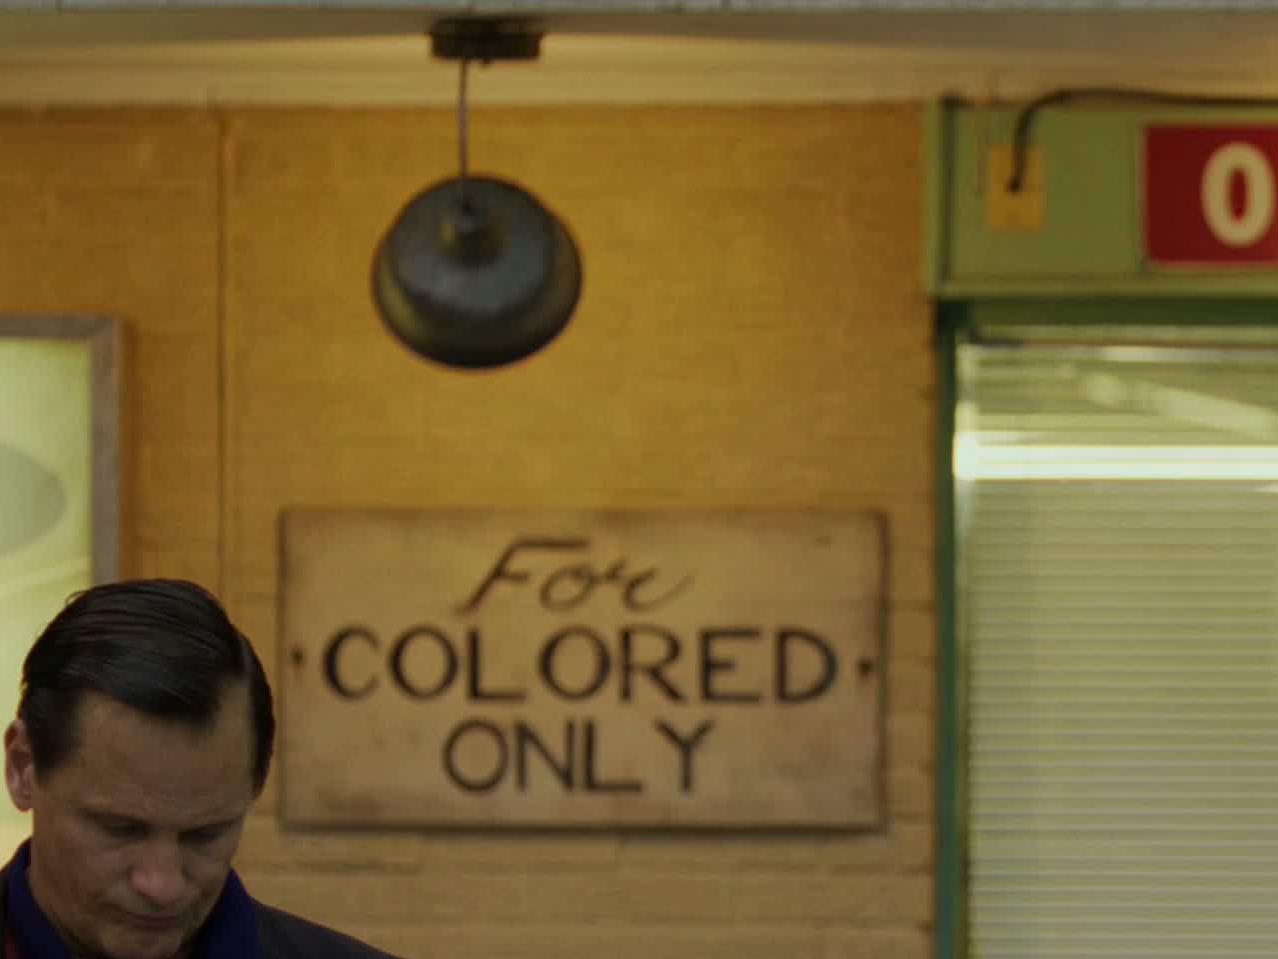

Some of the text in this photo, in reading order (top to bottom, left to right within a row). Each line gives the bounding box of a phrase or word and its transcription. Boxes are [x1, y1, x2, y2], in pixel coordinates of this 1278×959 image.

[454, 537, 692, 616] For
[322, 624, 838, 704] COLORED
[442, 719, 715, 794] ONLY
